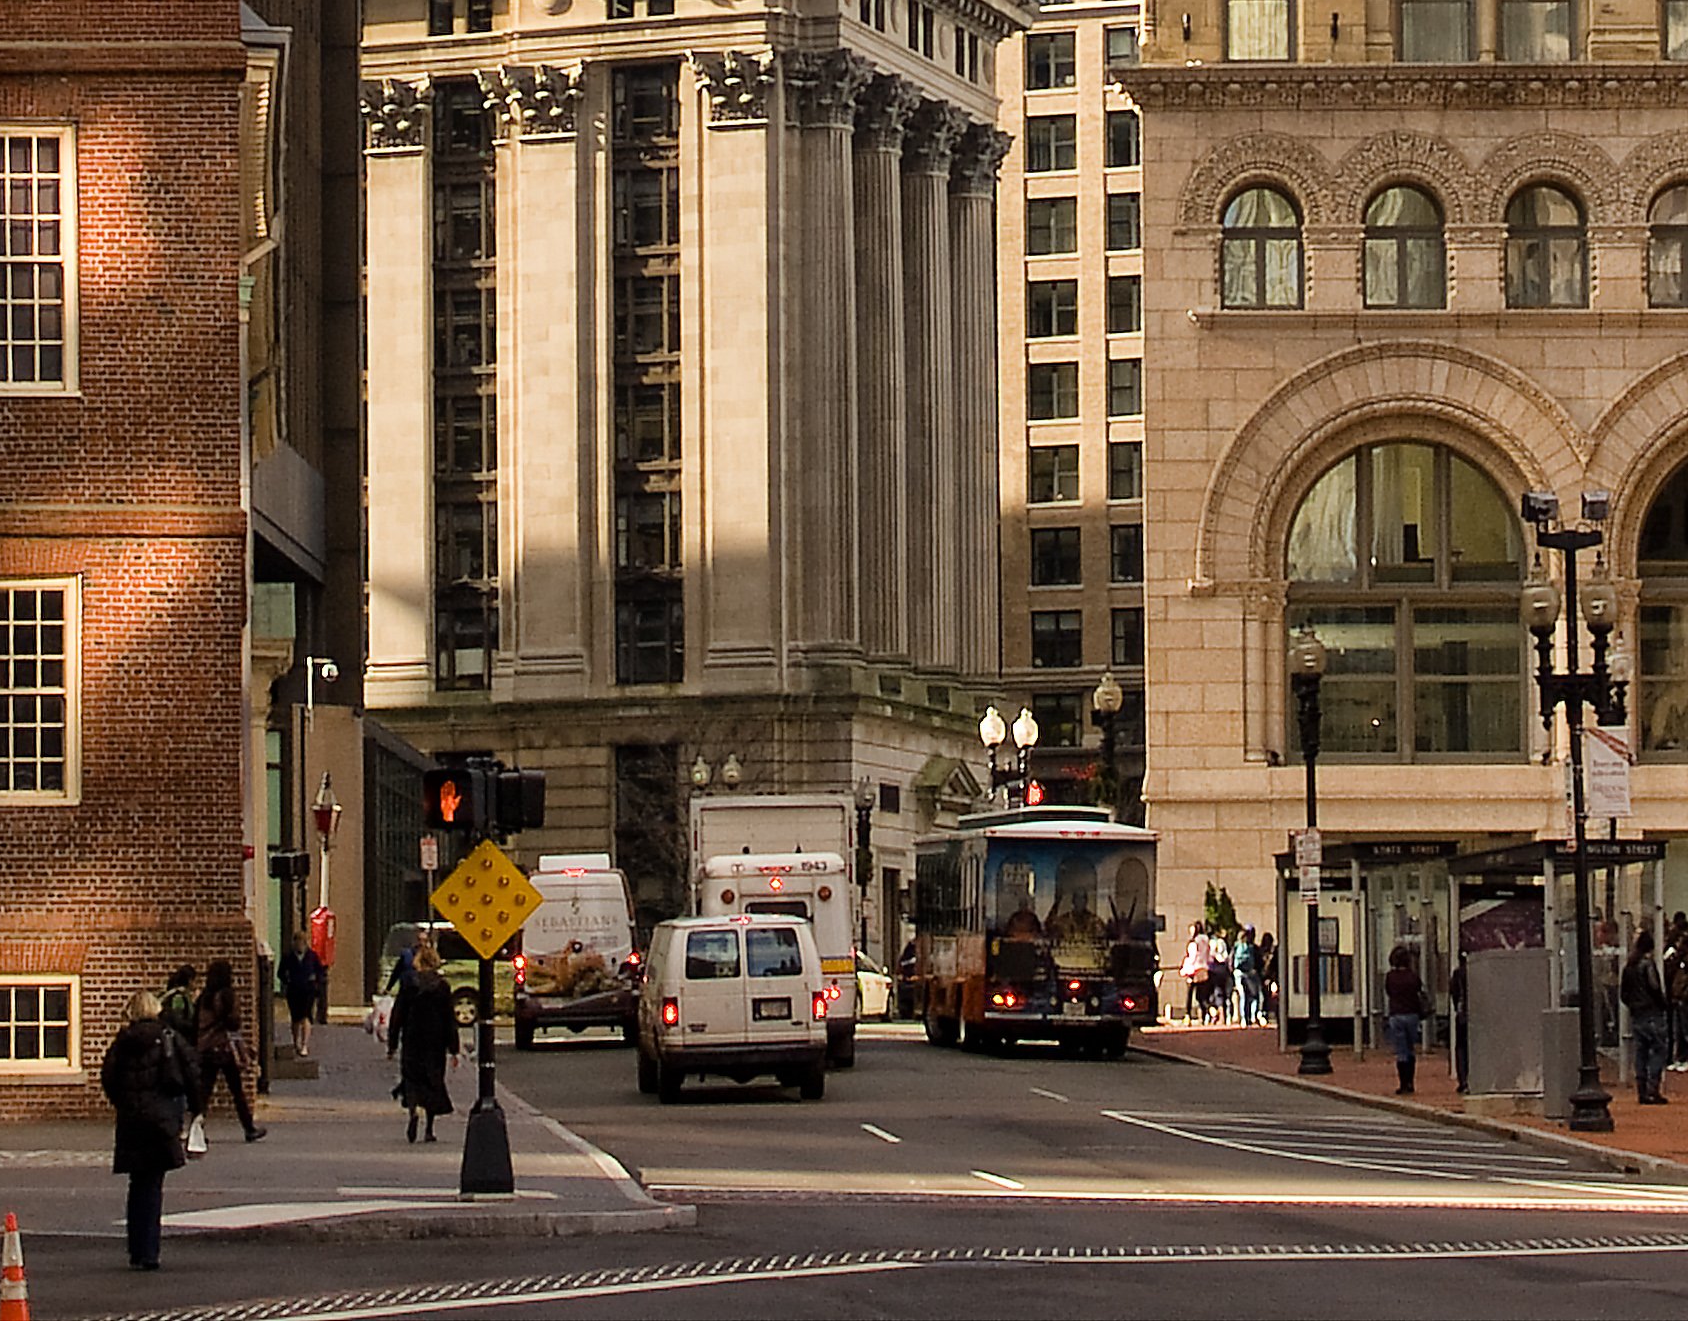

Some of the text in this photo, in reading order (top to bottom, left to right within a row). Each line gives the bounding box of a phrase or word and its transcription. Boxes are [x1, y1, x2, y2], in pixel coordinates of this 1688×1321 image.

[1373, 846, 1441, 855] STATE STREET
[1626, 844, 1657, 855] STREET
